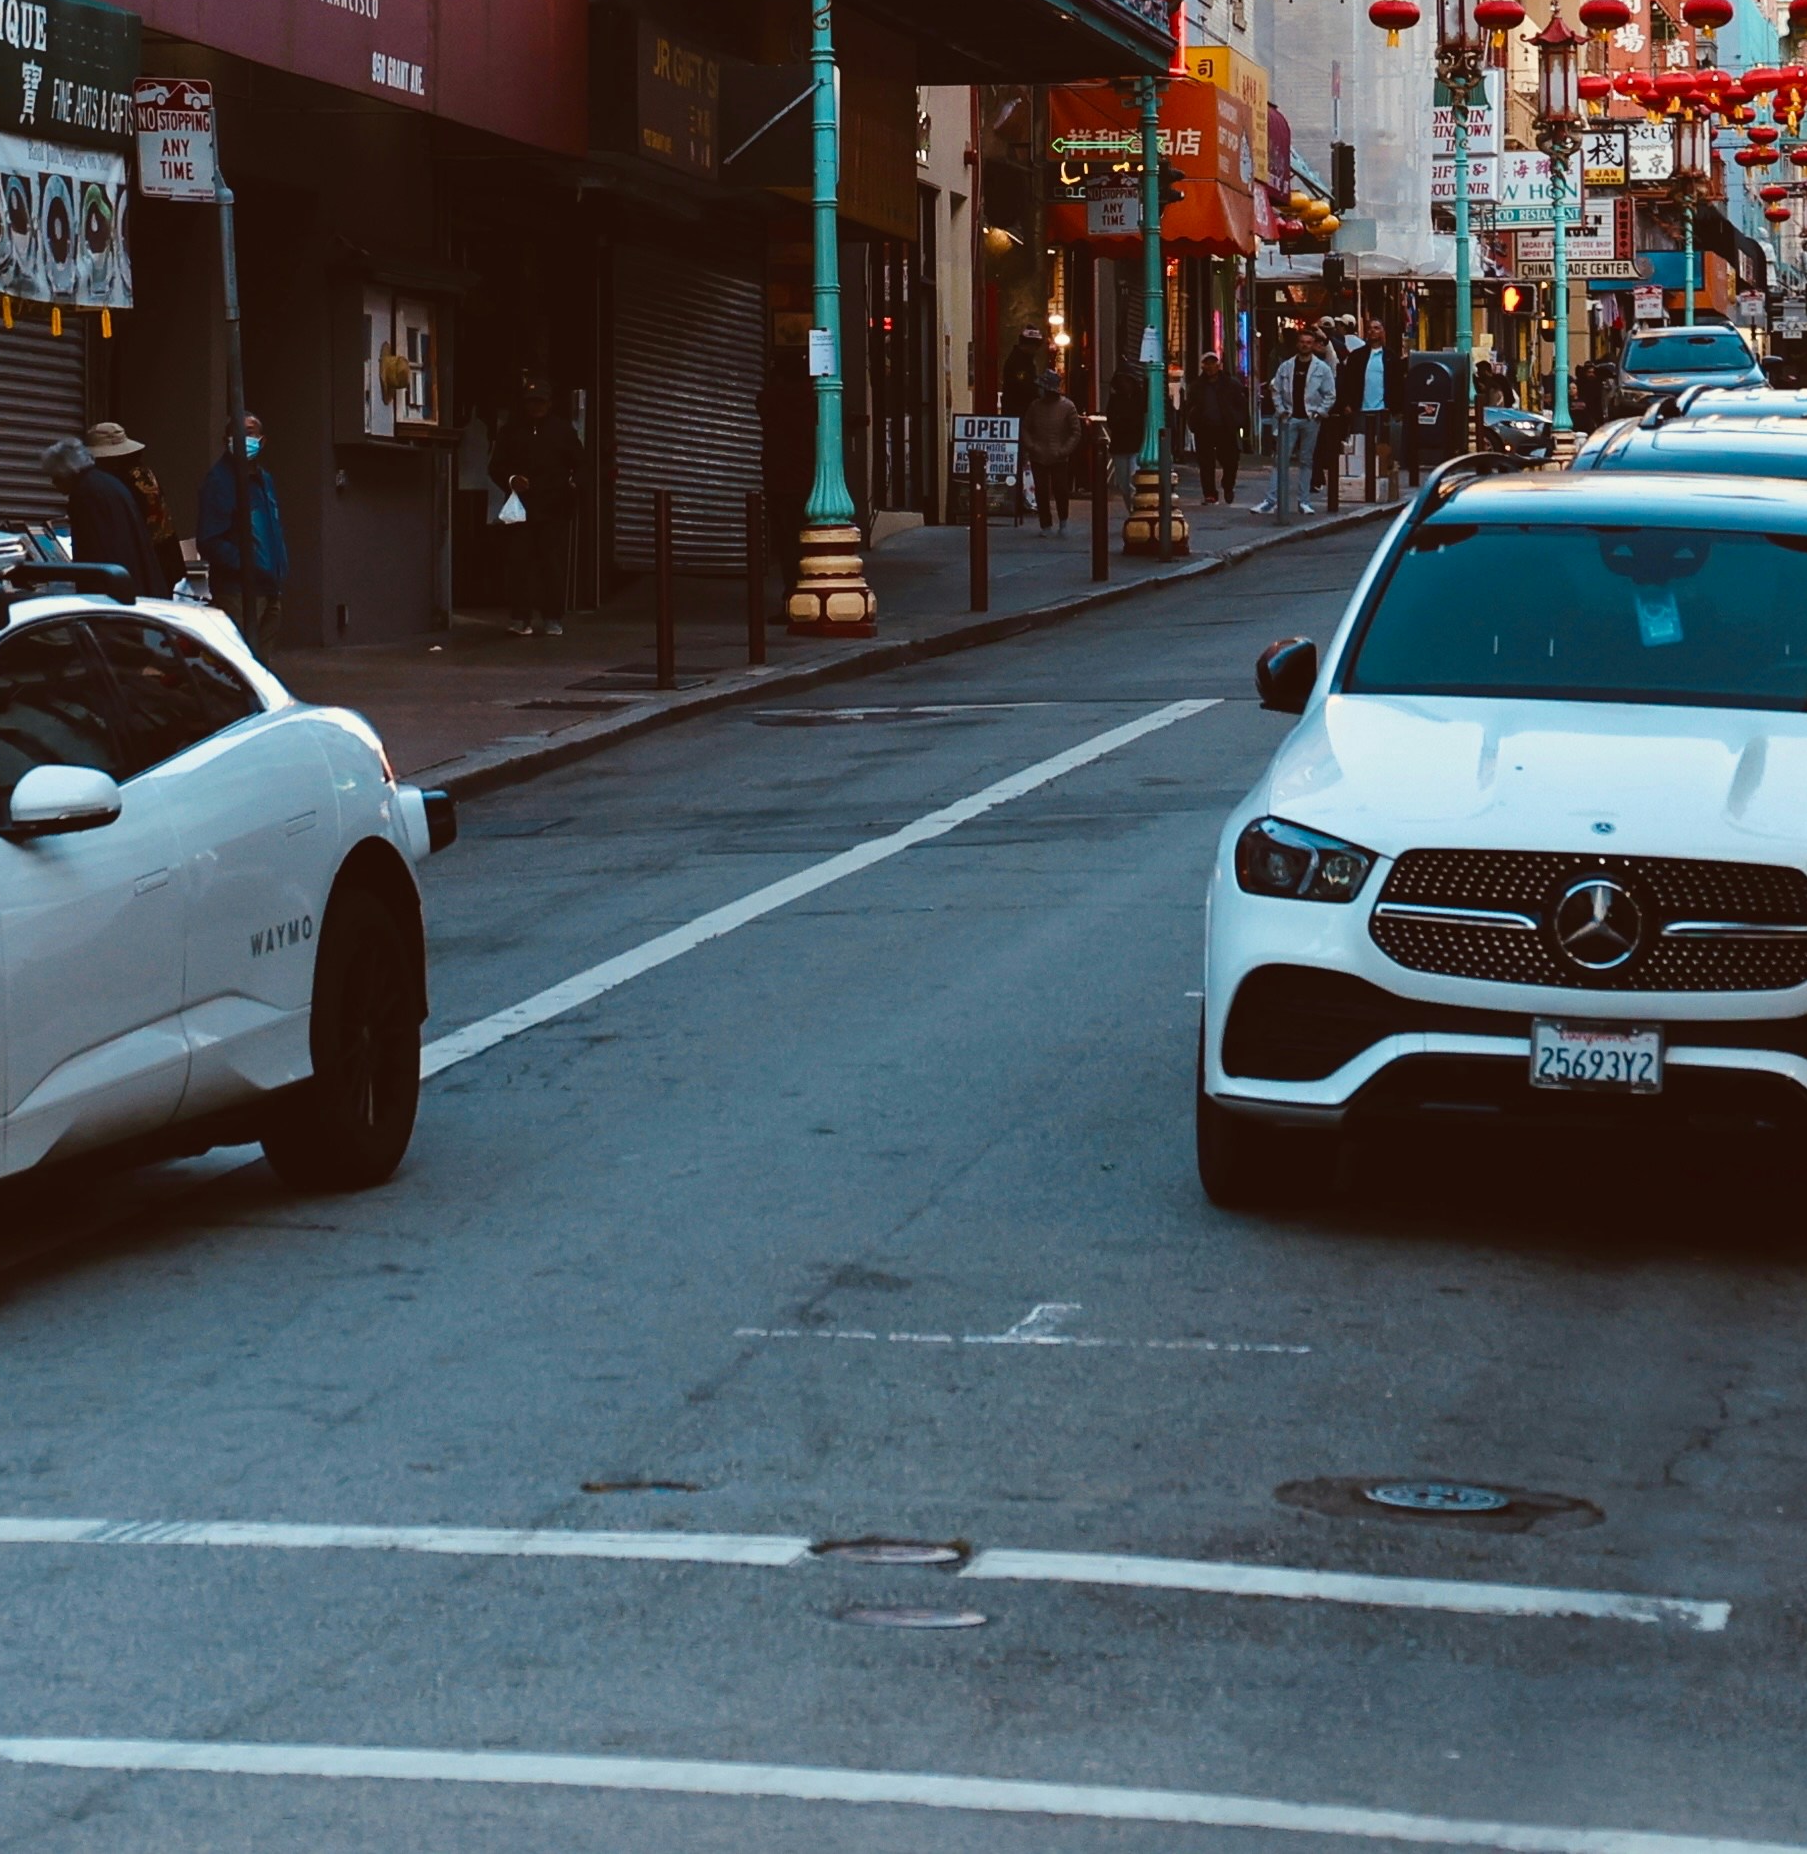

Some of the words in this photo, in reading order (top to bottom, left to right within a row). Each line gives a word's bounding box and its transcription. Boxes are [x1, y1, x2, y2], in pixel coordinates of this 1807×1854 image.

[387, 55, 410, 92] GRANT
[51, 77, 74, 124] FINE
[73, 84, 100, 130] ARTS
[99, 92, 108, 132] &
[109, 91, 136, 138] GIFTS
[137, 107, 158, 129] NO
[159, 111, 211, 134] STOPPING
[161, 138, 190, 159] ANY
[160, 160, 195, 182] TIME
[1103, 202, 1124, 214] ANY
[1101, 215, 1126, 226] TIME
[1521, 262, 1552, 277] CHINA
[1590, 261, 1631, 276] CENTER
[963, 418, 1012, 439] OPEN
[250, 914, 314, 959] WAYMO
[1538, 1046, 1654, 1083] 25693Y2
